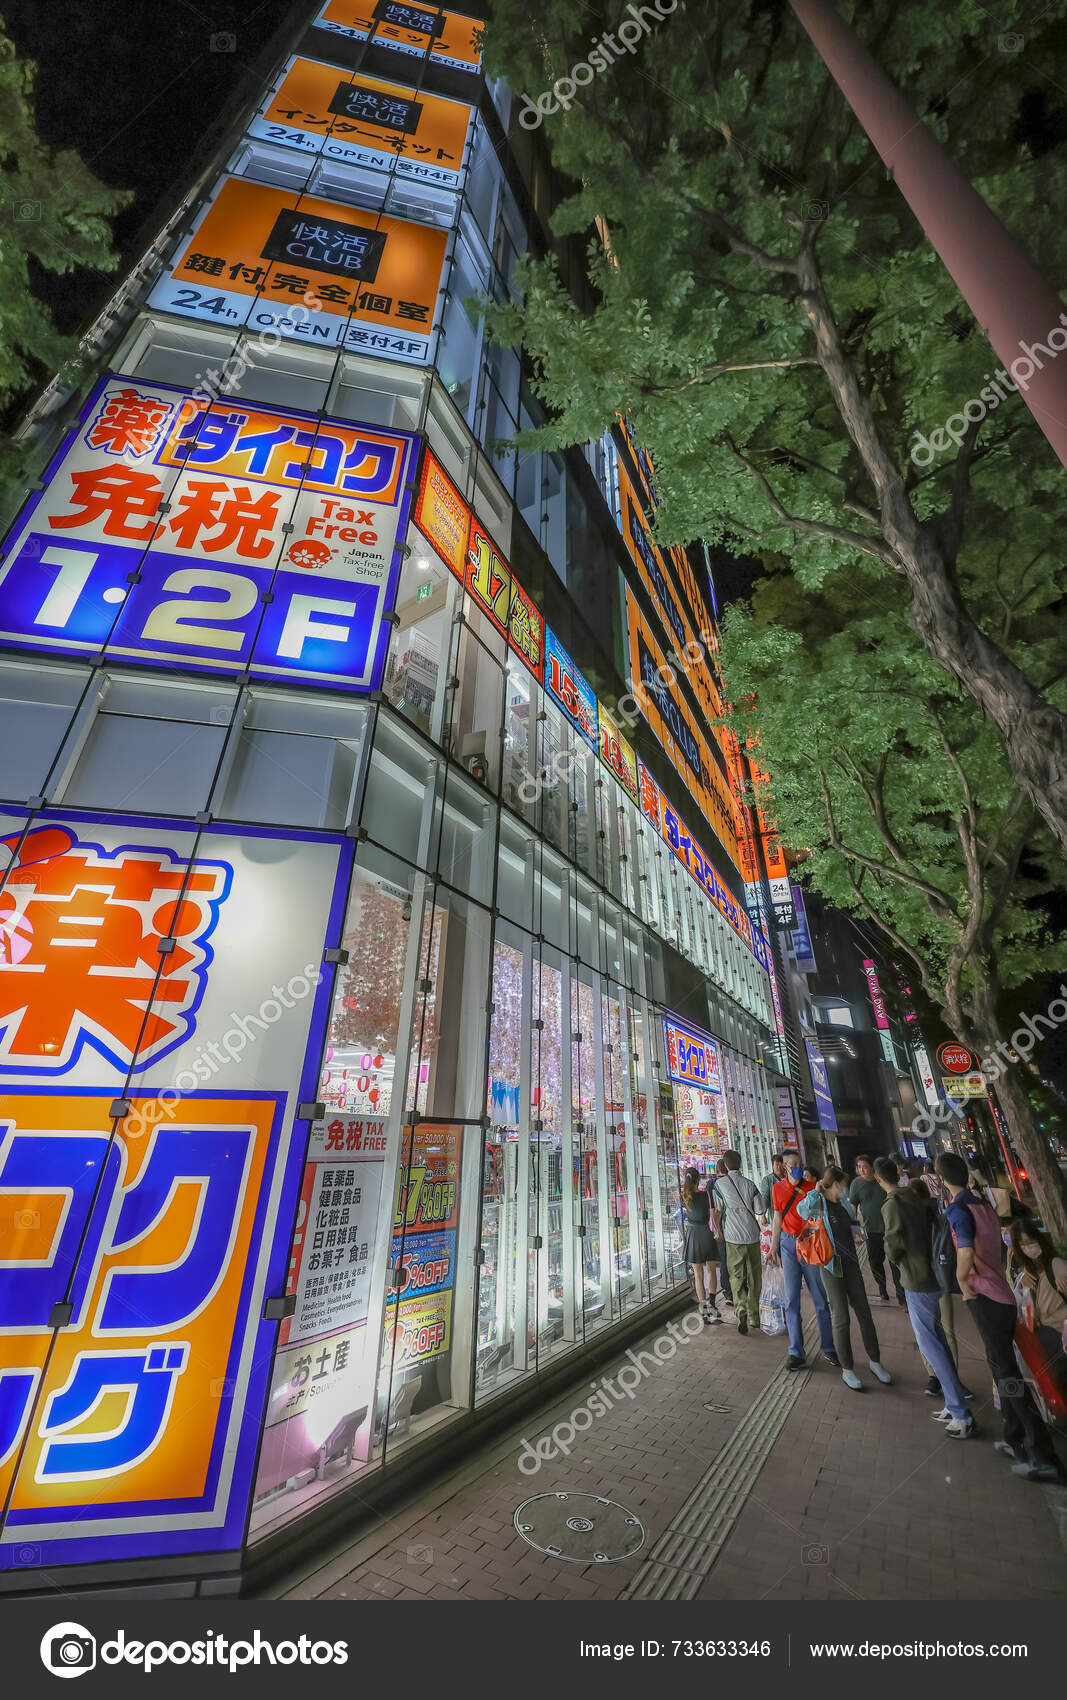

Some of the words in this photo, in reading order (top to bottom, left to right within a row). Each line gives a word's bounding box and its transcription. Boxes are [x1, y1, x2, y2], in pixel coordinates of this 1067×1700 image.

[385, 13, 433, 32] CLUB
[386, 4, 436, 25] 快活
[353, 17, 451, 50] コミック
[373, 38, 419, 56] OPEN
[345, 103, 406, 127] CLUB
[348, 90, 409, 117] 快活
[276, 108, 456, 161] インターネット
[328, 145, 384, 166] OPEN
[395, 161, 455, 184] 受付4F
[291, 220, 370, 256] 快活
[285, 242, 364, 270] CLUB
[183, 252, 430, 323] 鍵付完全個室
[256, 312, 330, 338] OPEN
[348, 329, 424, 355] 受付4F
[86, 388, 171, 456] 薬
[173, 411, 399, 494] ダイコク
[48, 463, 284, 560] 免税
[318, 498, 377, 527] Tax
[304, 516, 379, 547] Free
[343, 556, 385, 570] Tax-free
[355, 565, 383, 578] Shop
[511, 618, 541, 666] OFF
[778, 915, 792, 924] 4F
[678, 1036, 706, 1080] ダイコク
[325, 1119, 363, 1151] 免税
[366, 1122, 385, 1136] TAX
[363, 1137, 388, 1151] FREE
[322, 1169, 354, 1188] 医薬品
[319, 1188, 361, 1208] 健康食品
[316, 1208, 350, 1228] 化粧品
[312, 1226, 357, 1250] 日用雑貨
[308, 1248, 344, 1271] お菓子
[349, 1243, 368, 1264] 食品
[302, 1300, 325, 1312] Medicine
[327, 1294, 341, 1305] Health
[299, 1321, 316, 1332] Snacks
[301, 1310, 325, 1322] Cosmetics
[291, 1340, 351, 1388] お土産
